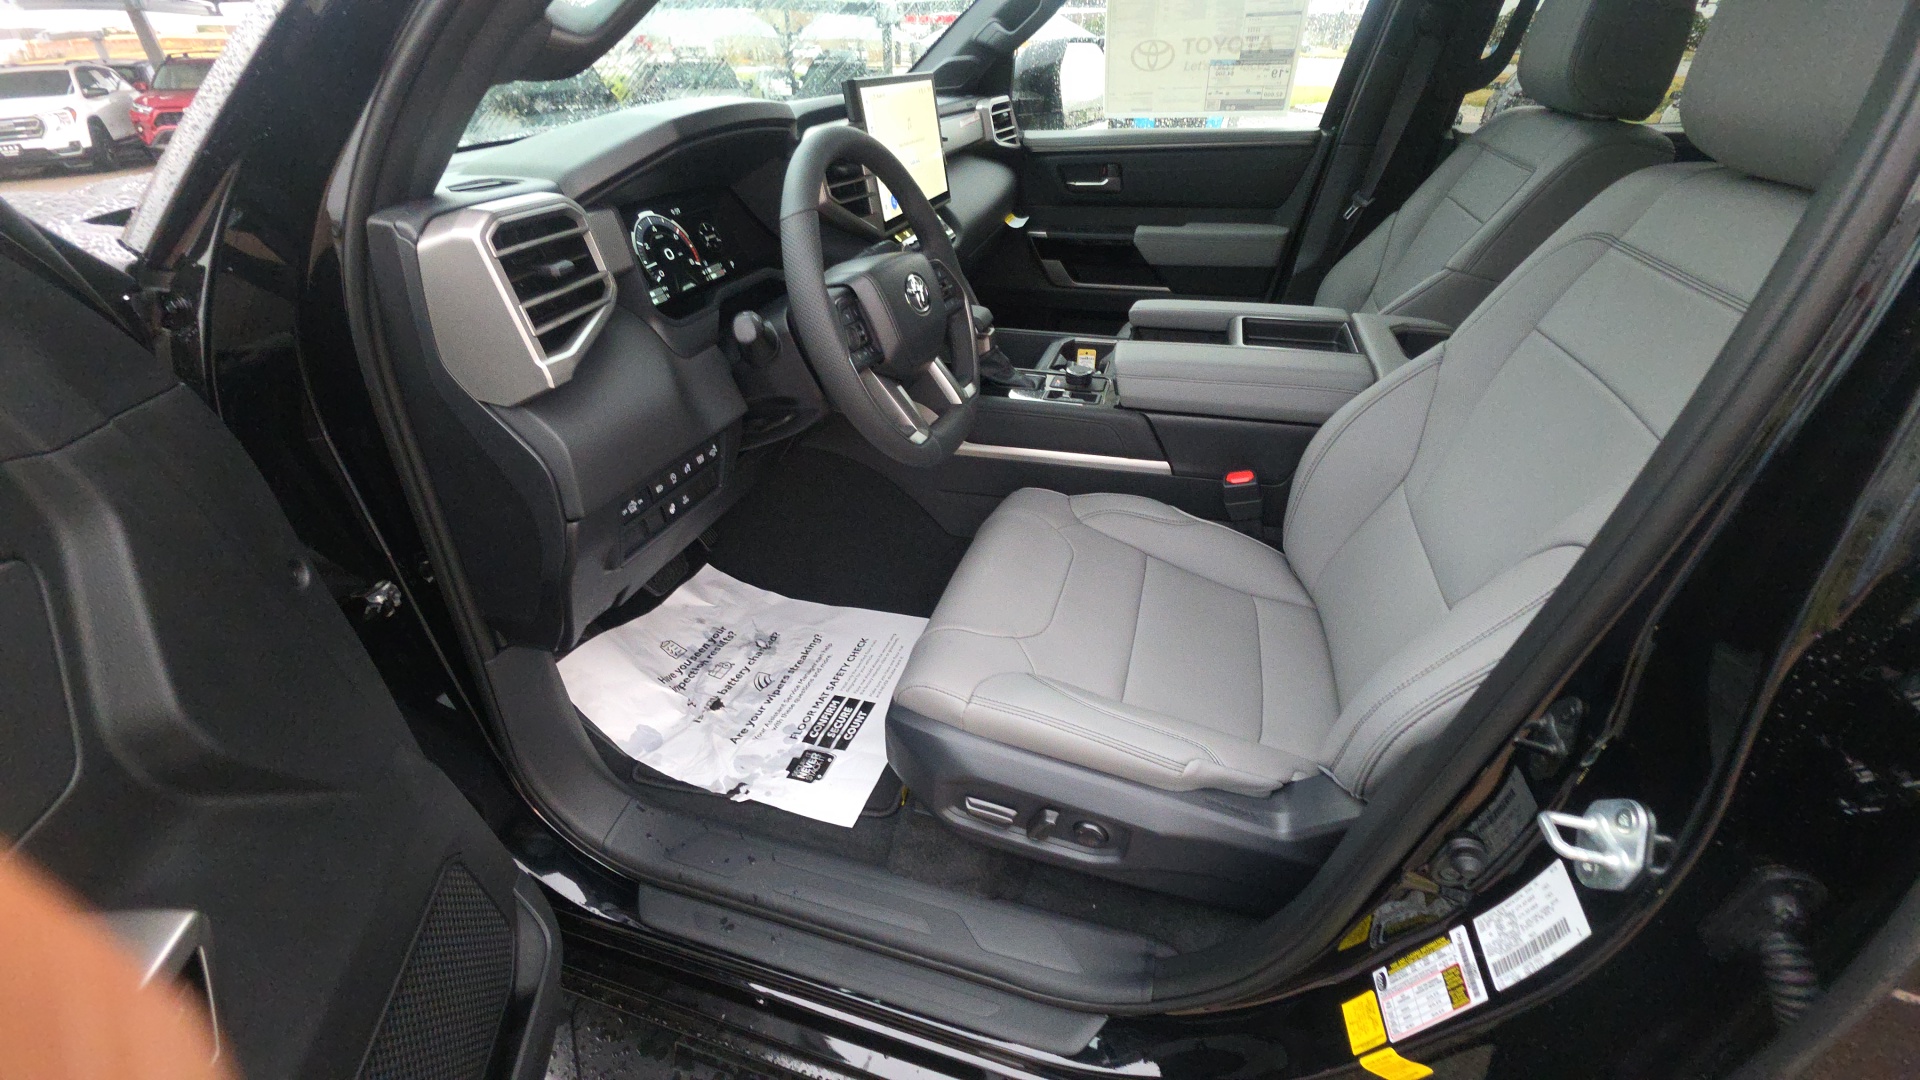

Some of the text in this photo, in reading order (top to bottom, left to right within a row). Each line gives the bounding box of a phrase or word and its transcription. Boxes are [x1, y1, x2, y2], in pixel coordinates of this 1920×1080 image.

[663, 247, 675, 260] 0
[669, 630, 737, 691] inpection results?
[675, 659, 692, 675] you
[690, 642, 711, 661] seen
[707, 626, 727, 645] your
[717, 665, 751, 695] battery
[748, 631, 780, 666] chaed?
[730, 633, 822, 745] Are your wipers streaking?
[790, 709, 816, 740] FLOOR
[815, 691, 830, 710] MAT
[826, 662, 850, 691] SAFETY
[846, 638, 869, 662] CHECK
[809, 700, 840, 738] CONFIRM
[826, 706, 853, 738] SECURE
[843, 710, 867, 741] COUNT
[796, 752, 820, 779] NEVER
